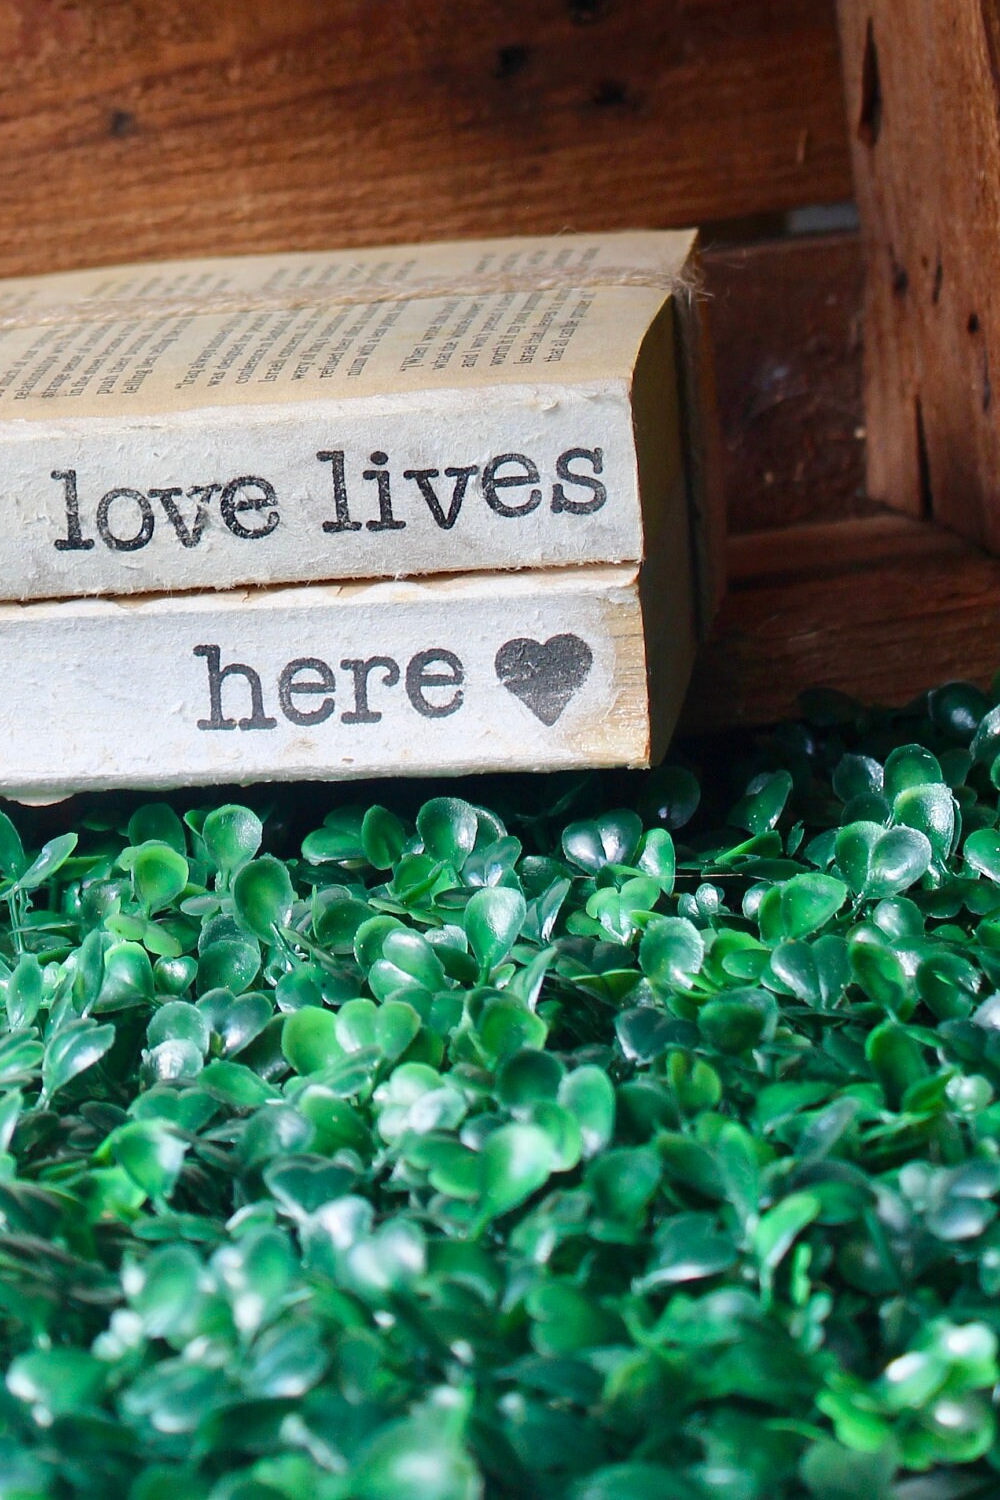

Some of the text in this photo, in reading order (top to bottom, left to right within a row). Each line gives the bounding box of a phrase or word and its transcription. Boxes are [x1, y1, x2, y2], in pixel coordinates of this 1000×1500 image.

[431, 353, 452, 370] what
[462, 355, 478, 367] and
[490, 346, 510, 366] worth
[513, 346, 538, 364] Israel
[544, 349, 564, 362] that
[236, 349, 267, 384] conference
[291, 362, 315, 380] wary
[319, 353, 344, 378] refused
[14, 356, 58, 400] relationships
[40, 374, 71, 398] strange
[72, 376, 92, 387] the
[97, 376, 118, 394] push
[121, 370, 152, 393] telling
[207, 372, 225, 386] was
[51, 448, 606, 551] love lives
[194, 645, 464, 730] here
